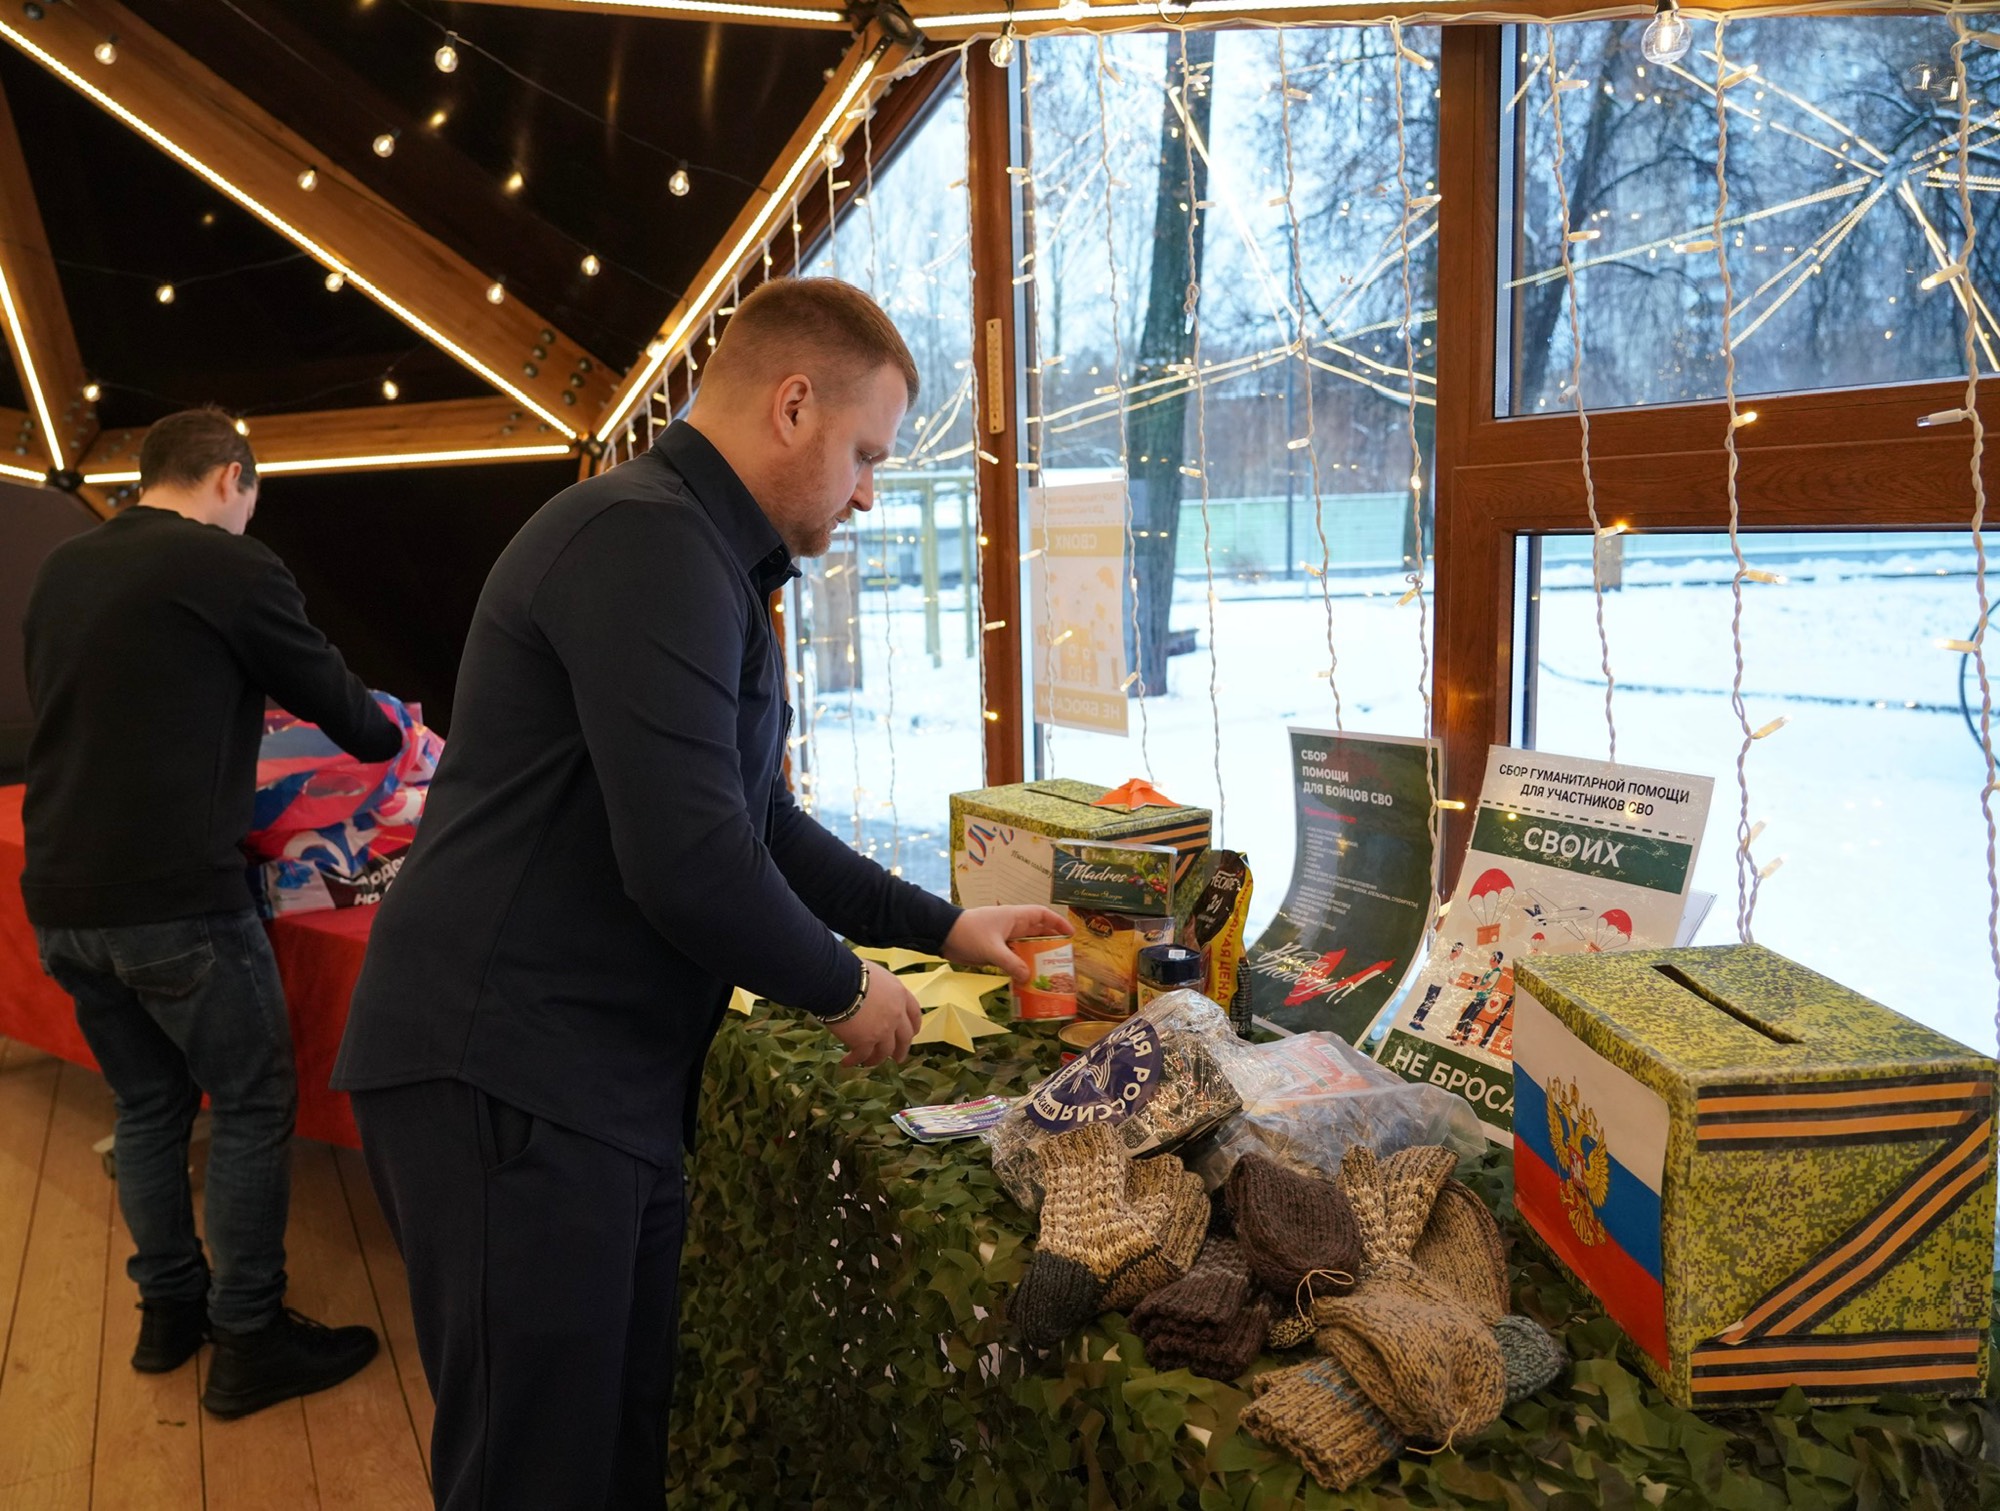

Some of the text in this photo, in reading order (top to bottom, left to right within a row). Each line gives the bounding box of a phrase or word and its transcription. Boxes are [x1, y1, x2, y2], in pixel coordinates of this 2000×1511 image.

[1301, 749, 1327, 763] СБОР
[1302, 766, 1349, 783] ПОМОЩИ
[1499, 764, 1690, 803] СБОР ГУМАНИТАРНОЙ ПОМОЩИ
[1303, 781, 1393, 807] ДЛЯ БОЙЦОВ СВО
[1520, 784, 1654, 816] ДЛЯ УЧАСТНИКОВ СВО
[1523, 827, 1624, 868] СВОИХ
[1058, 860, 1128, 884] Madres
[1216, 961, 1231, 1001] ЦЕНА
[1392, 1046, 1429, 1078] НЕ
